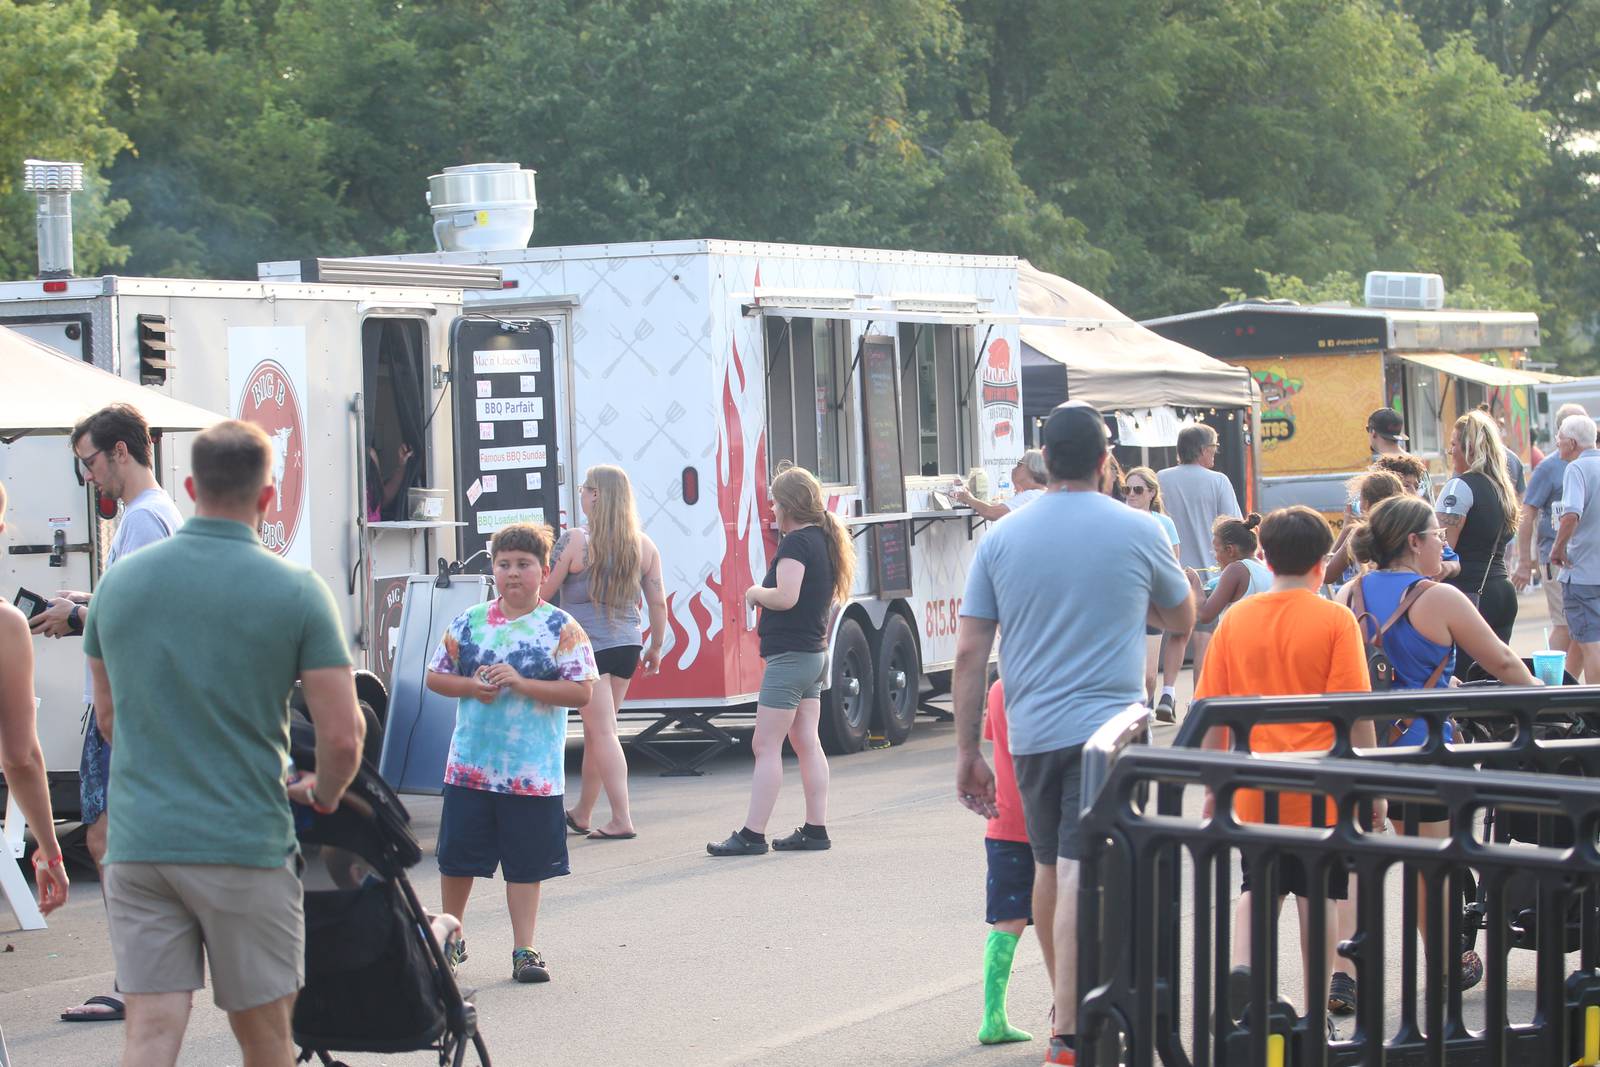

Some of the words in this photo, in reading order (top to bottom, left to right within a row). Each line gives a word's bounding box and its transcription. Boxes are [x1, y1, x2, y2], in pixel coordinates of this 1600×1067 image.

[497, 353, 521, 366] Cheese
[522, 353, 540, 369] Wrap
[252, 373, 274, 409] BIG
[275, 379, 286, 406] B
[485, 402, 502, 415] BBQ
[505, 400, 534, 413] Parfait
[480, 453, 505, 463] Famous
[506, 451, 521, 462] BBQ
[522, 450, 546, 461] Sundae
[478, 516, 494, 528] BBQ
[494, 513, 518, 525] Loaded
[261, 520, 286, 549] BBQ
[386, 587, 401, 609] BIG
